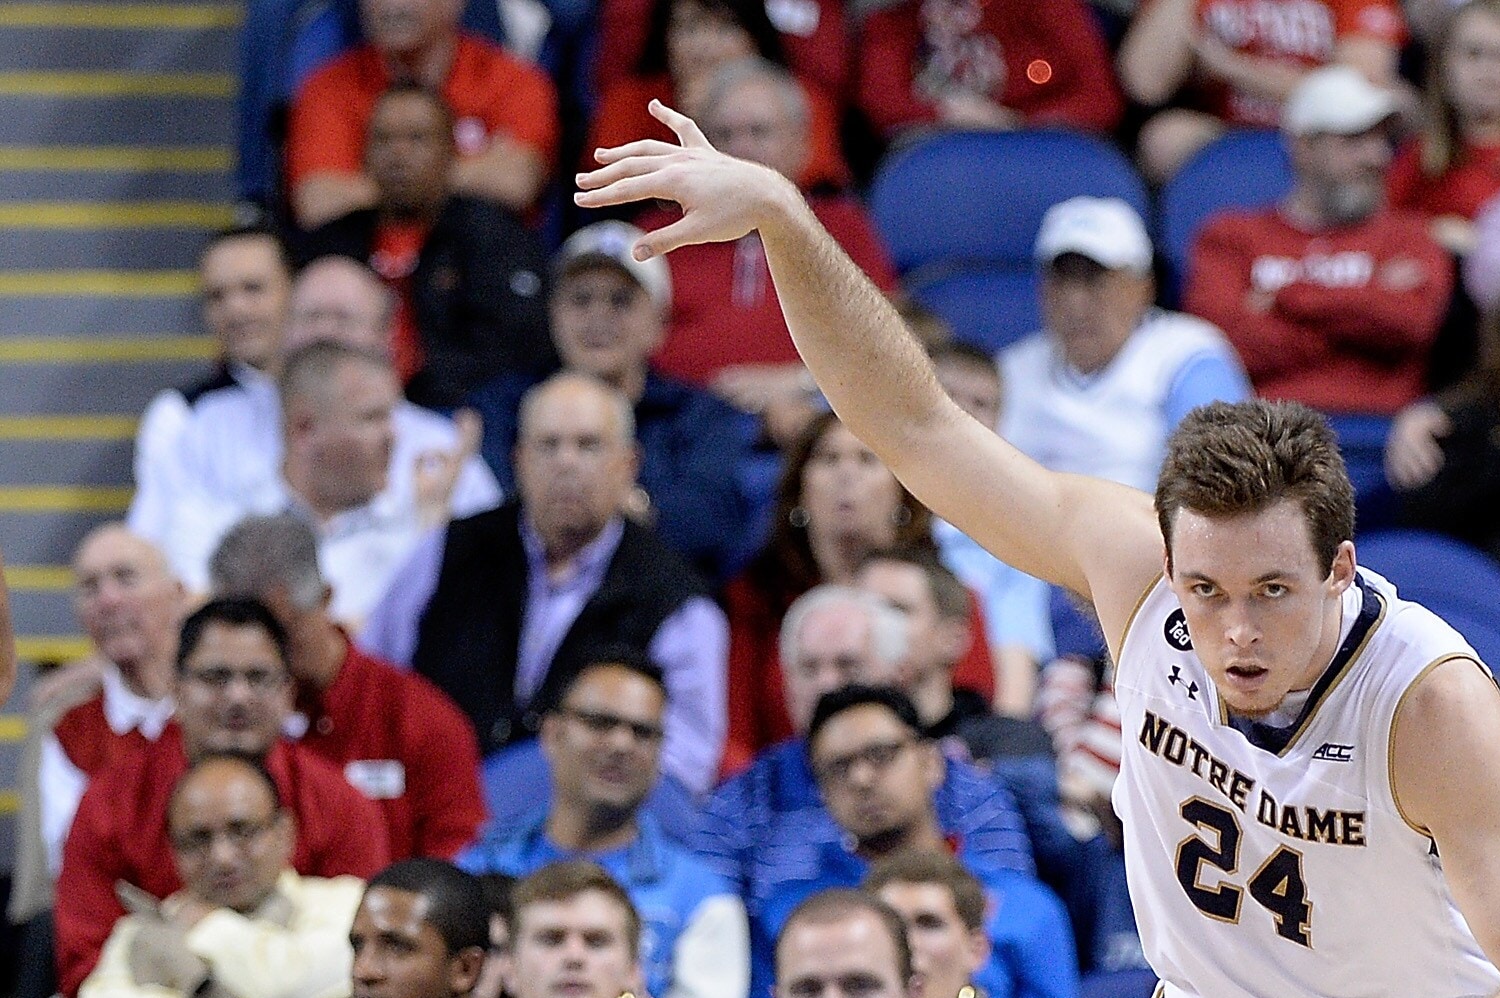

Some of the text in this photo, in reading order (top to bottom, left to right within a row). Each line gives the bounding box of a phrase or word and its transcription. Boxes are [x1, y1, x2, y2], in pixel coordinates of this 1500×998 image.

[1139, 708, 1368, 848] NOTRE DAME
[1312, 742, 1355, 762] ACC
[1174, 794, 1315, 951] 24
